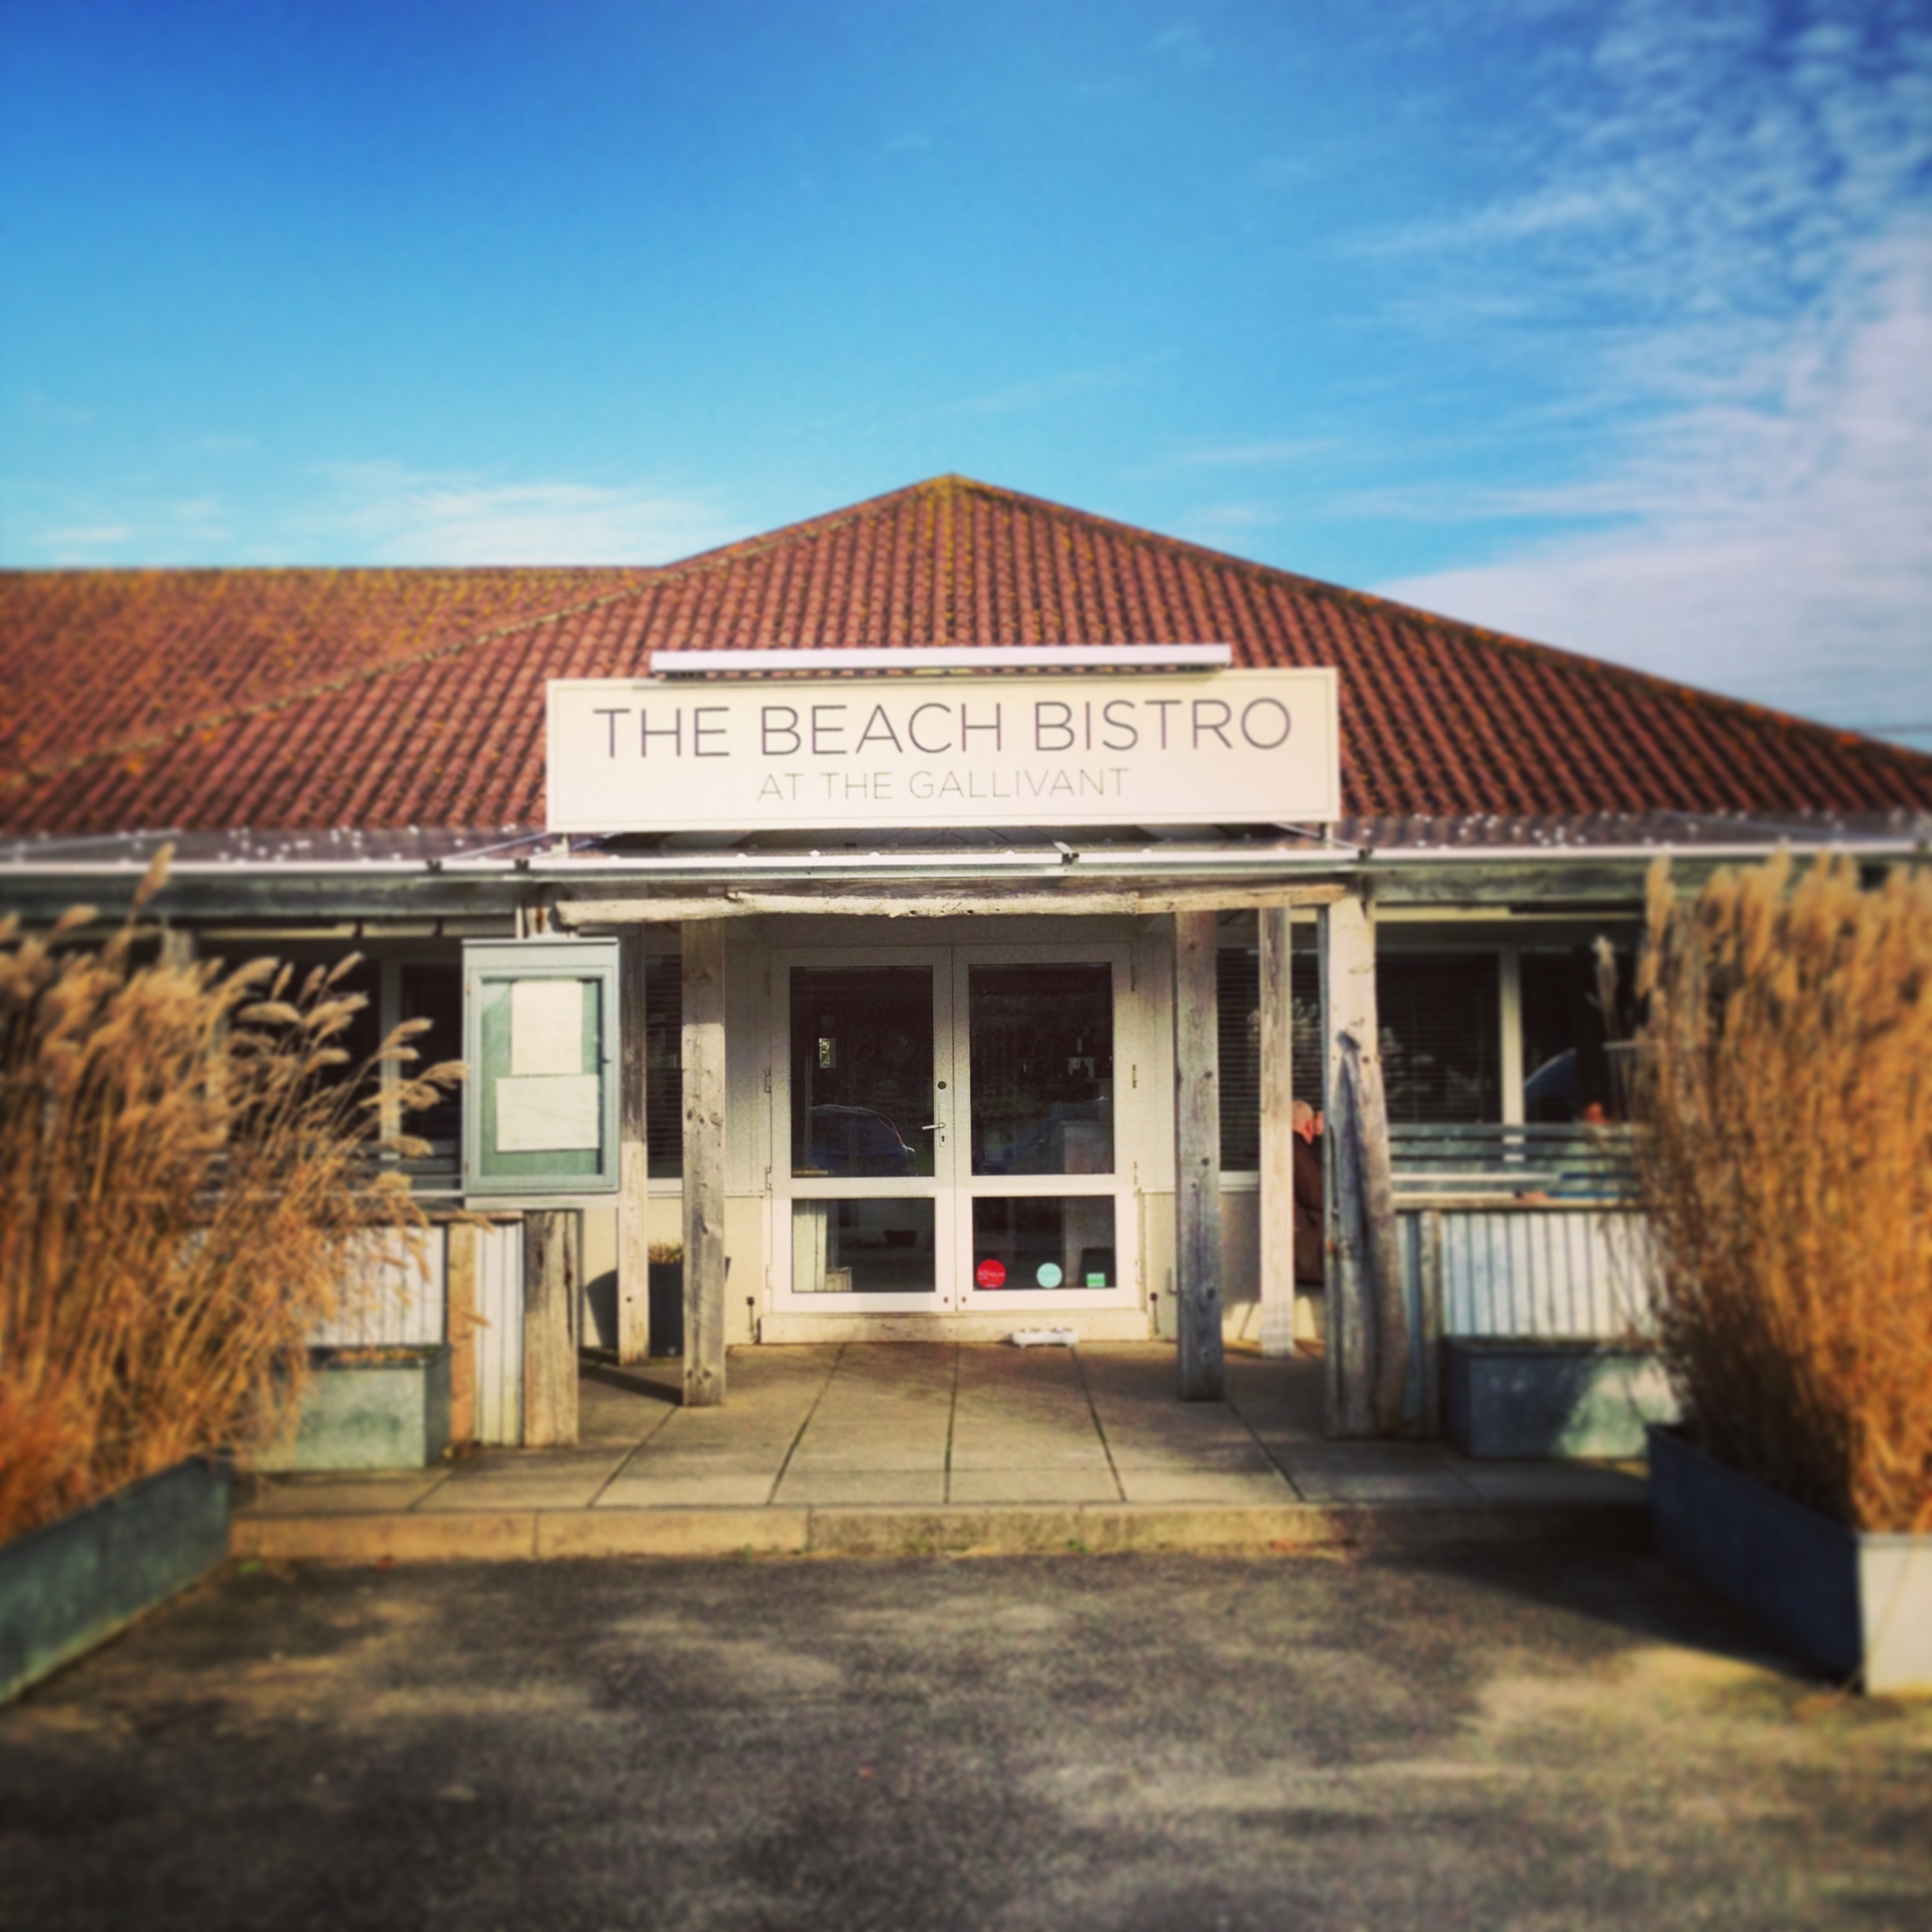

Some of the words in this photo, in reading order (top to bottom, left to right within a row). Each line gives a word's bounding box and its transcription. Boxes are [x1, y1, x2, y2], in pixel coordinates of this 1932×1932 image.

[593, 706, 731, 758] THE
[762, 702, 1001, 756] BEACH
[1035, 697, 1291, 751] BISTRO
[758, 772, 804, 801] AT
[819, 771, 893, 800] THE
[909, 767, 1129, 799] GALLIVANT
